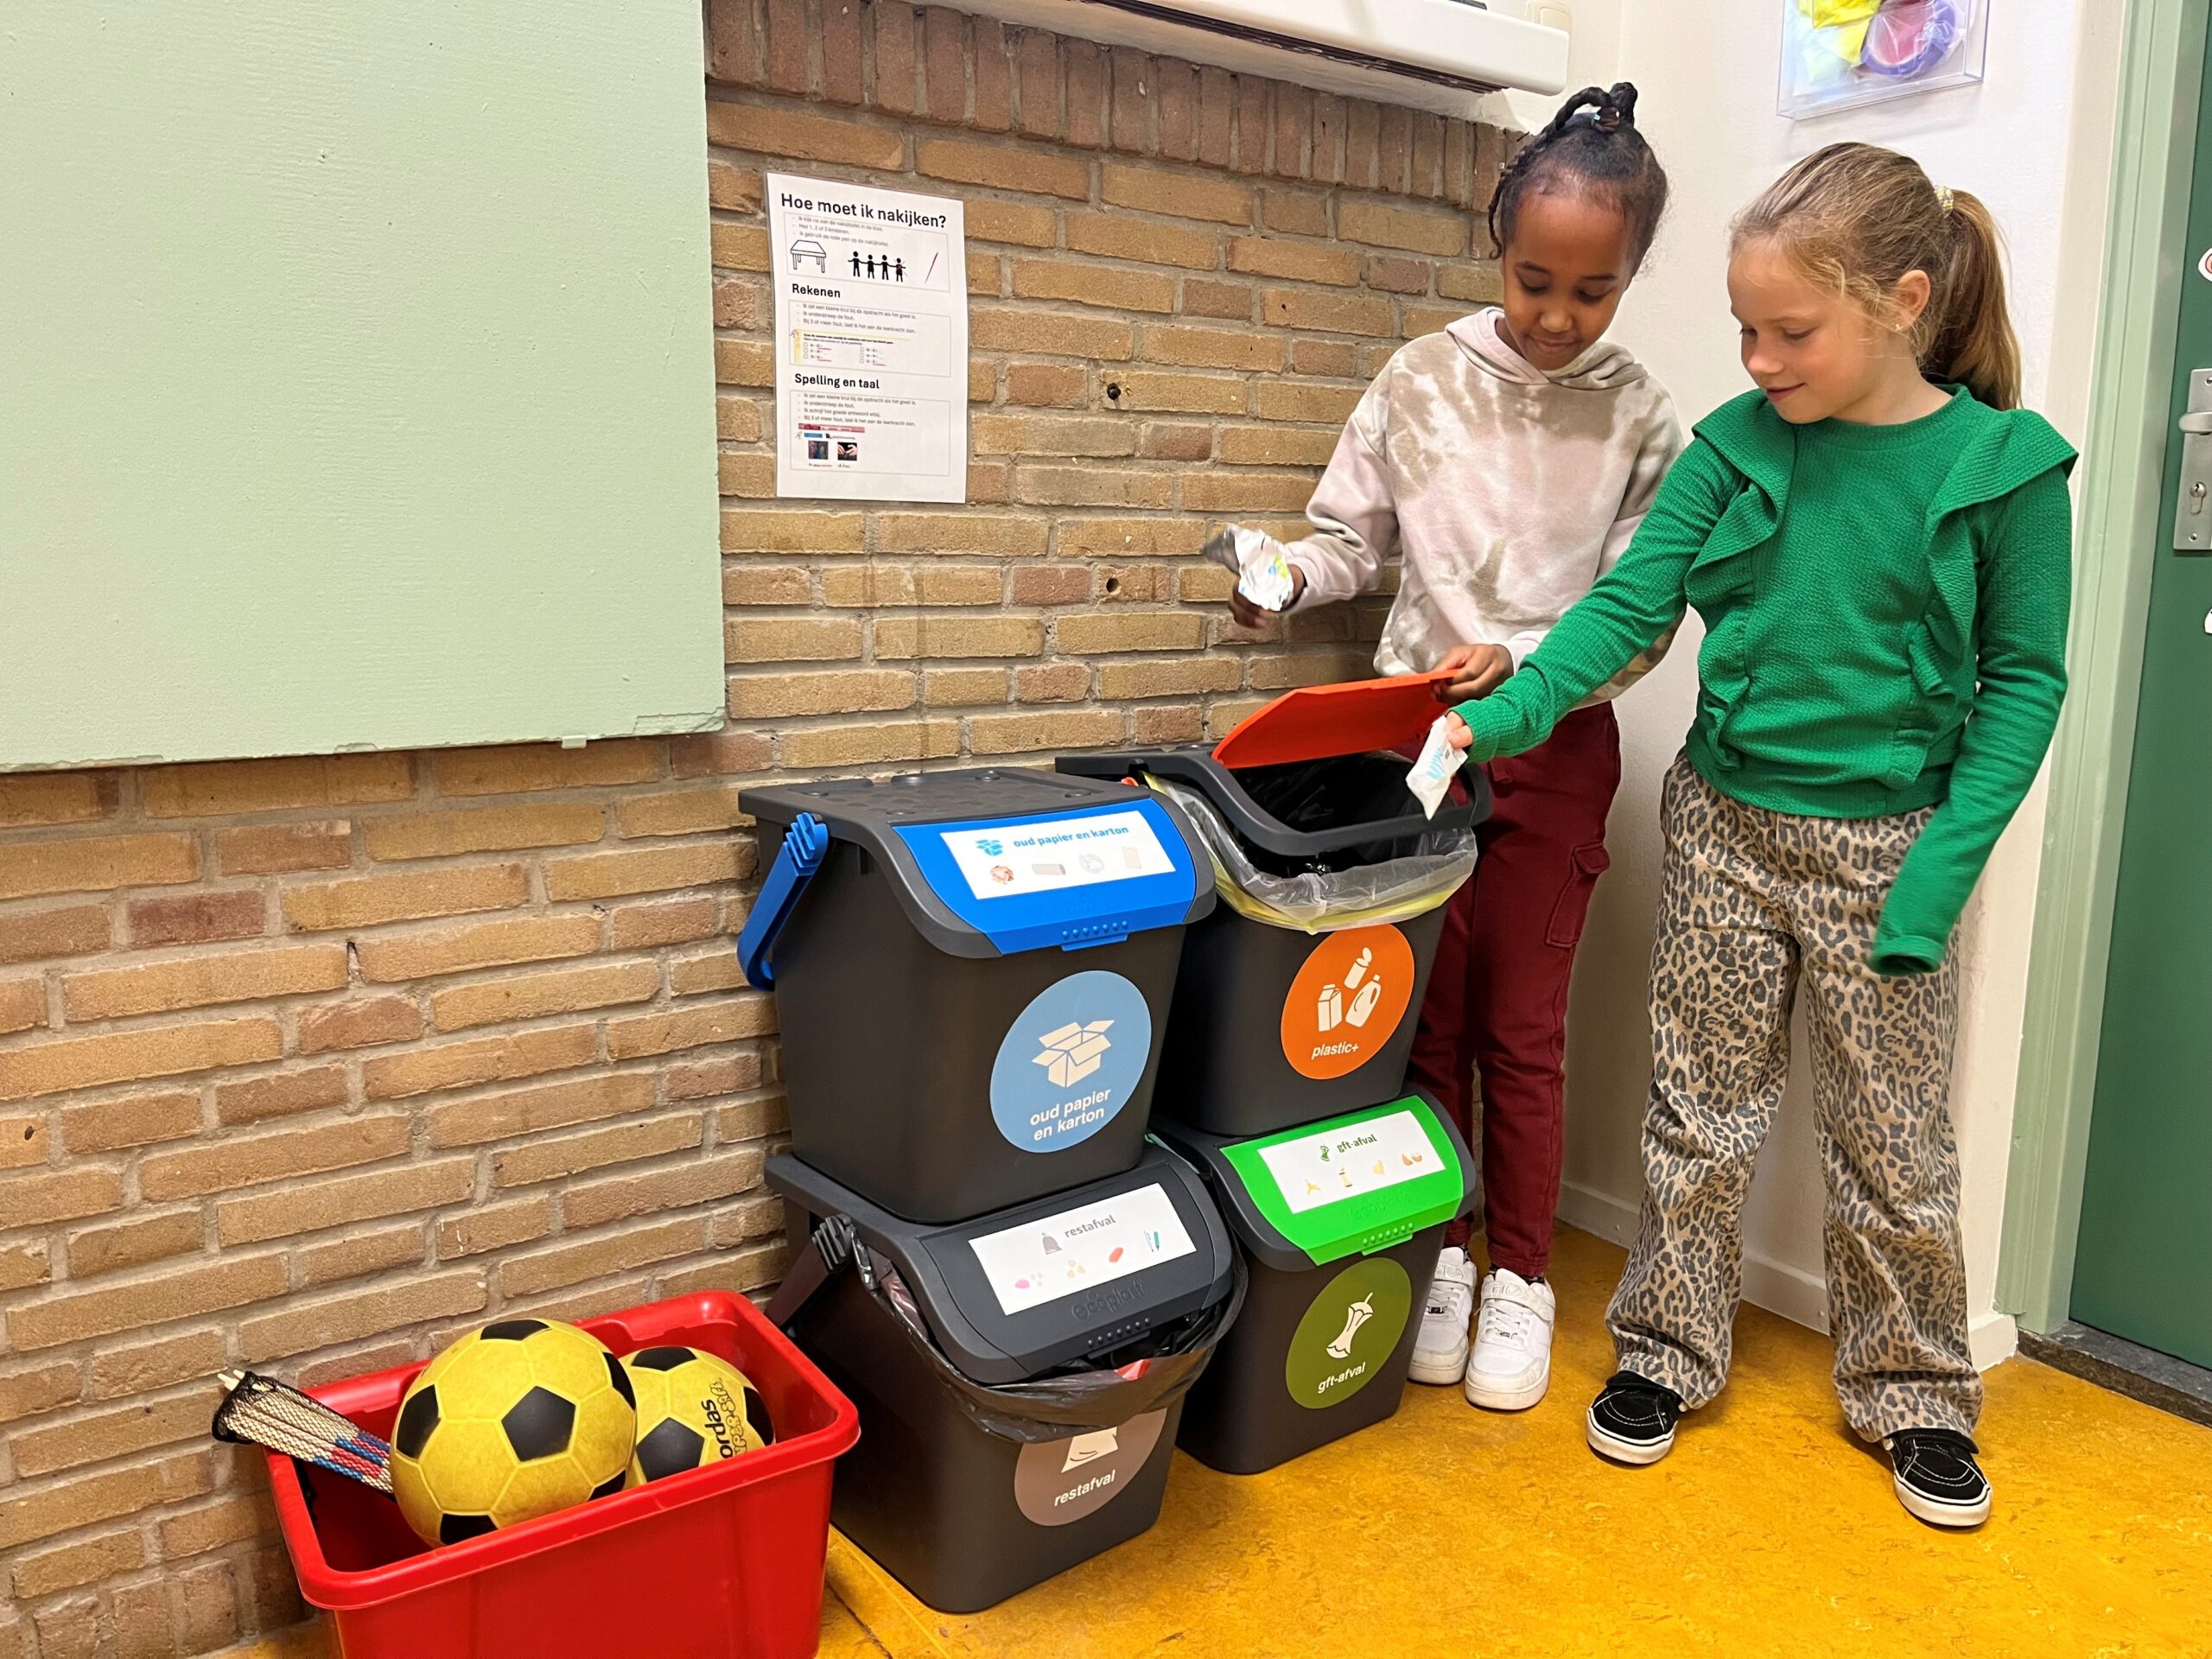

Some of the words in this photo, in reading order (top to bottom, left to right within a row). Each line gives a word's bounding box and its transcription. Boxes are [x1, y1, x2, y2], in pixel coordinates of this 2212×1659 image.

[781, 194, 812, 210] Hoe
[818, 201, 857, 216] moet
[861, 206, 874, 219] ik
[878, 209, 947, 228] nakijken?
[792, 283, 841, 298] Rekenen
[795, 374, 840, 389] Spelling
[843, 378, 855, 387] en
[859, 378, 880, 389] taal
[1014, 836, 1035, 848] oud
[1039, 832, 1073, 847] papier
[1076, 831, 1090, 840] en
[1091, 826, 1129, 838] karton
[1311, 1041, 1359, 1060] plastic+
[1030, 1103, 1059, 1126] oud
[1064, 1089, 1111, 1117] papier
[1034, 1126, 1052, 1141] en
[1058, 1108, 1104, 1133] karton
[1337, 1134, 1377, 1154] gft-afval
[1065, 1215, 1116, 1238] restafval
[1319, 1362, 1366, 1394] gft-afval
[1054, 1469, 1116, 1507] restafval
